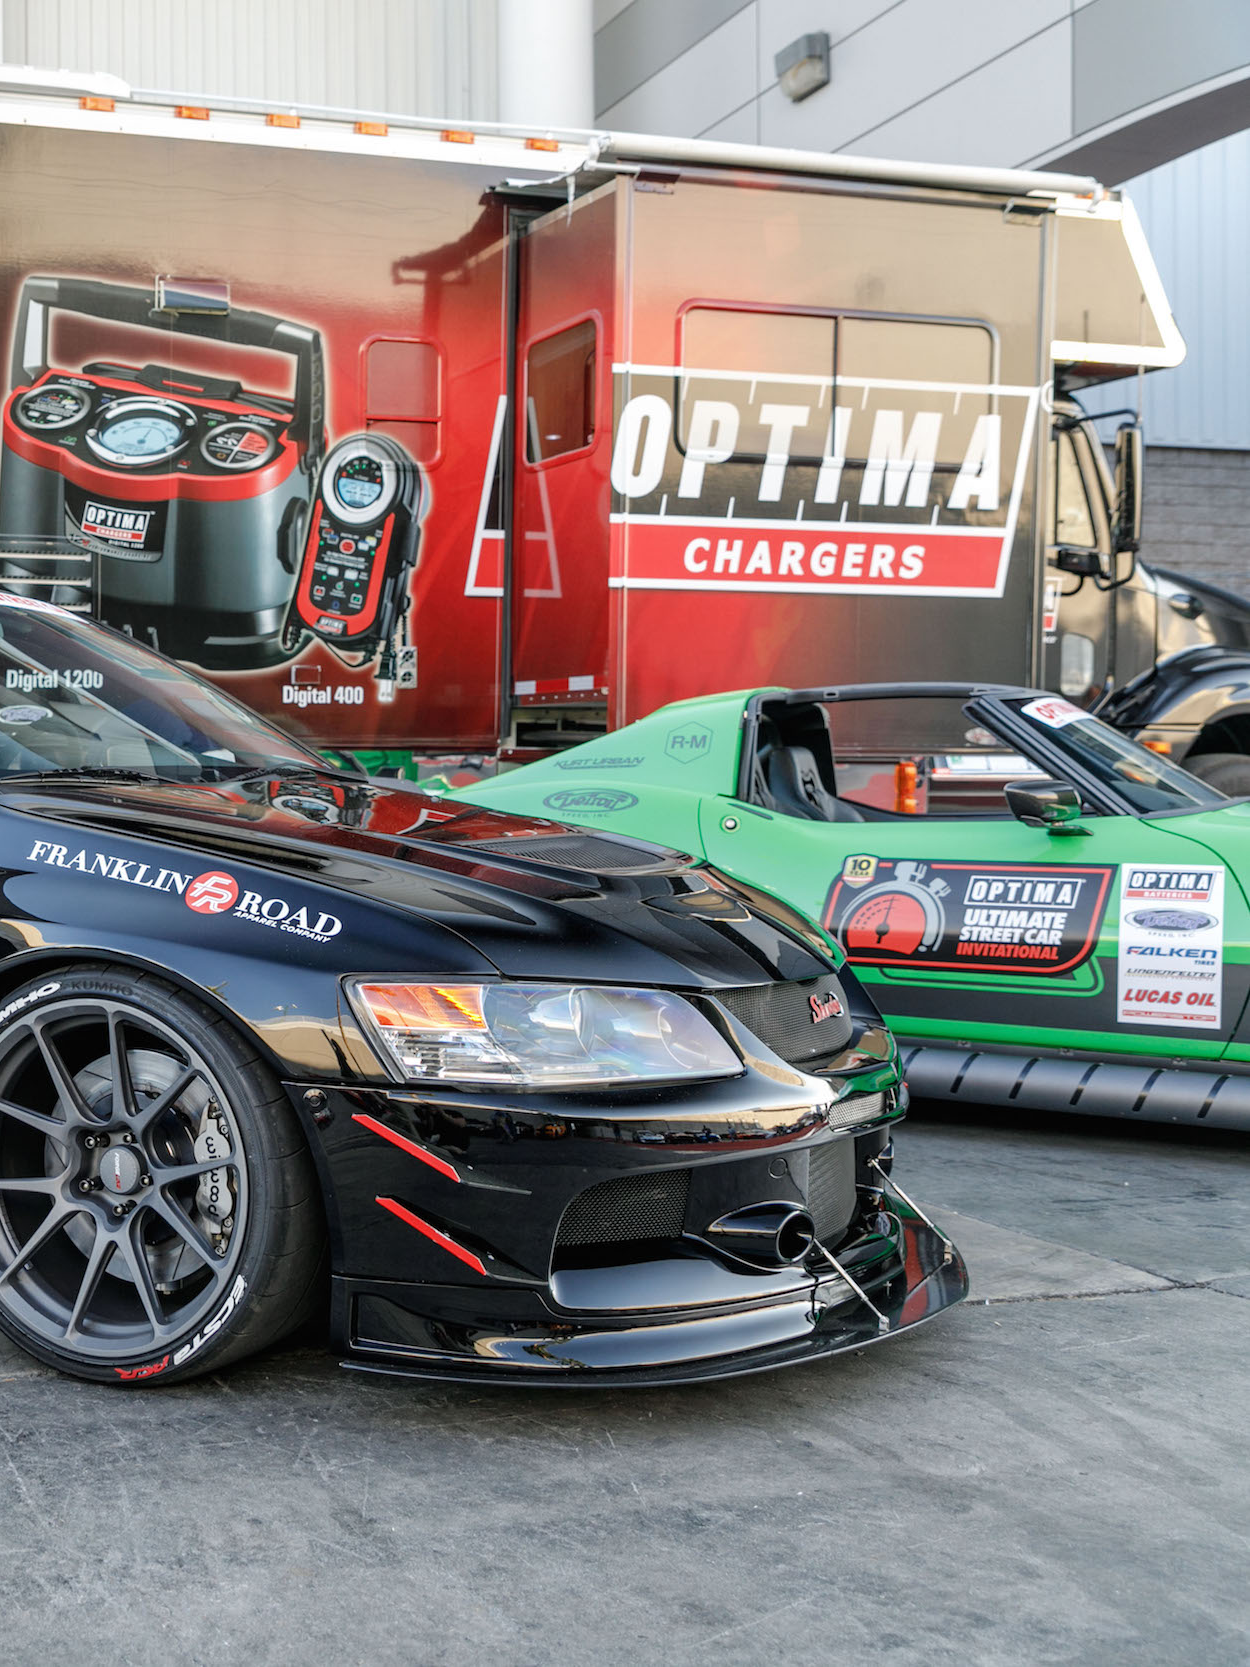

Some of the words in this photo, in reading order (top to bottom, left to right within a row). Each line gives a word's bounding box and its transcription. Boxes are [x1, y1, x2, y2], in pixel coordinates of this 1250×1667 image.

[610, 394, 1001, 511] OPTIMA
[87, 507, 145, 530] OPTIMA
[96, 527, 132, 539] CHARGERS
[684, 537, 925, 579] CHARGERS
[6, 669, 58, 692] Digital
[282, 685, 332, 708] Digital
[334, 686, 364, 704] 400
[671, 735, 707, 748] R-M
[553, 758, 589, 768] KURT
[592, 756, 645, 766] URBAN
[852, 859, 871, 871] 10
[26, 840, 193, 895] FRANKLIN
[235, 890, 342, 937] ROAD
[1130, 872, 1210, 890] OPTIMA
[971, 881, 1072, 904] OPTIMA
[233, 911, 277, 927] APPAREL
[280, 924, 331, 943] COMPANY
[963, 909, 1068, 929] ULTIMATE
[959, 927, 1021, 942] STREET
[1022, 929, 1061, 945] CAR
[956, 942, 1059, 960] INVITATIONAL
[1127, 946, 1217, 959] FALKEN
[71, 980, 135, 996] KUMHO
[1124, 988, 1183, 1005] LUCAS
[1186, 992, 1215, 1007] OIL
[205, 1136, 219, 1217] wiwood
